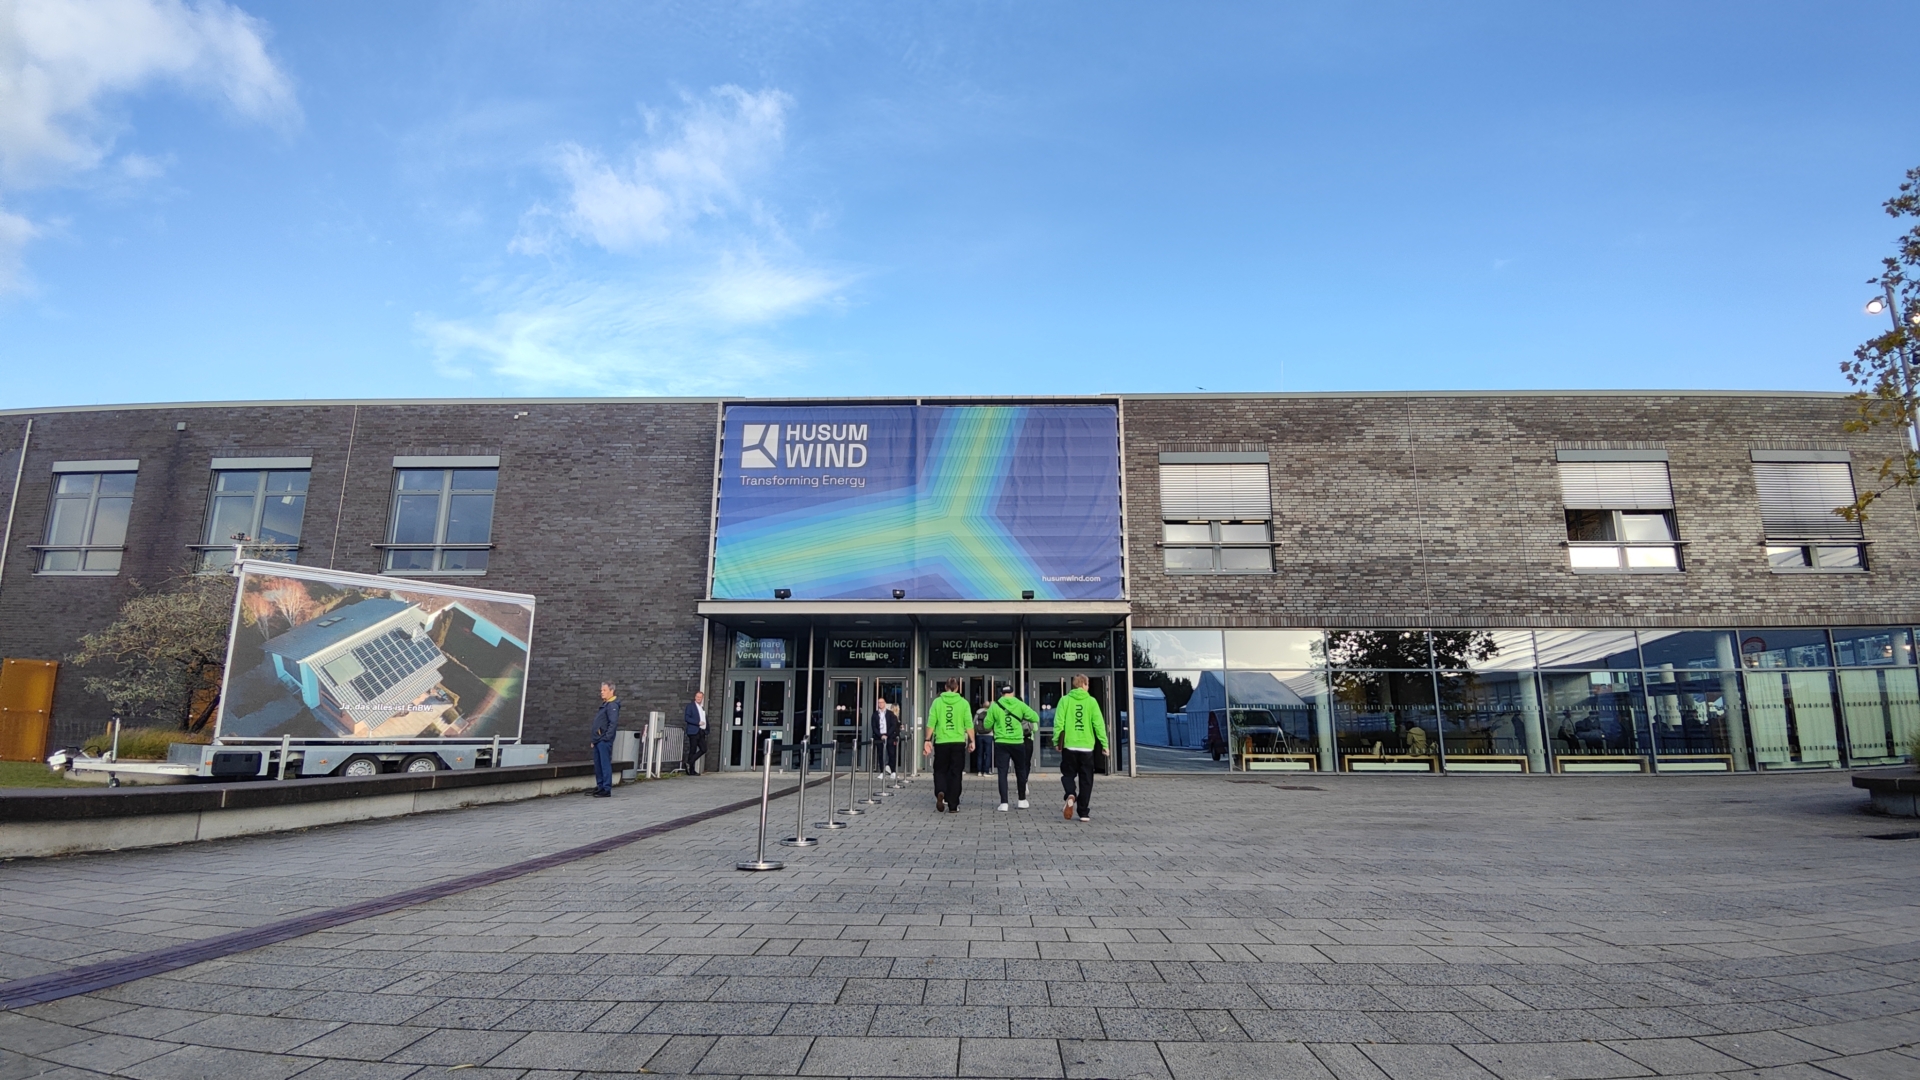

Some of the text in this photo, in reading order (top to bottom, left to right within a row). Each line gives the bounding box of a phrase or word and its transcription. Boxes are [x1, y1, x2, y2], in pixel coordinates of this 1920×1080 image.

[786, 424, 868, 441] HUSUM
[785, 443, 867, 468] WIND
[740, 475, 866, 487] Transforming Energy
[739, 640, 781, 648] Seminare
[833, 640, 854, 648] NCC
[861, 640, 906, 648] Exhibition
[942, 640, 963, 648] NCC
[970, 640, 999, 648] Messe
[1035, 640, 1056, 648] NCC
[1064, 640, 1106, 648] Messehal
[737, 651, 787, 661] Verwaltung
[339, 703, 352, 711] Ja,
[354, 703, 370, 711] das
[407, 704, 434, 712] EnBW.
[946, 705, 954, 731] noxt!
[1075, 704, 1085, 732] noxt!
